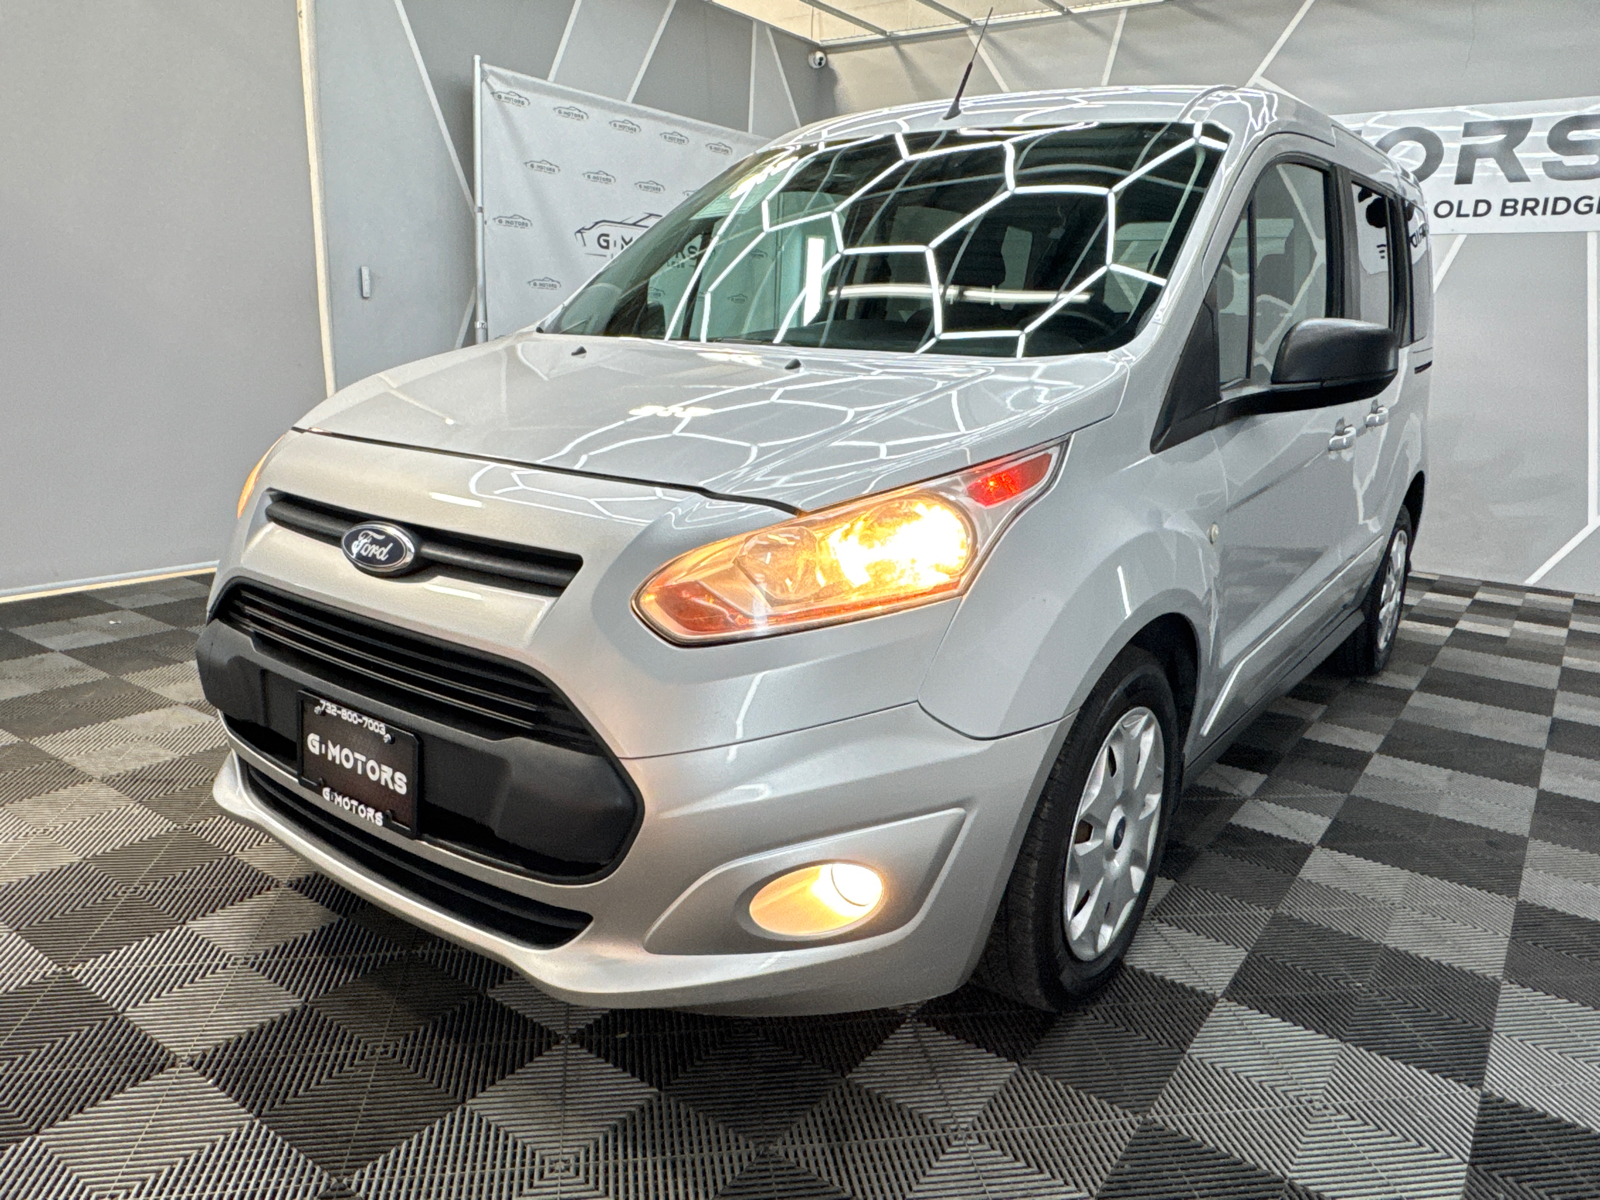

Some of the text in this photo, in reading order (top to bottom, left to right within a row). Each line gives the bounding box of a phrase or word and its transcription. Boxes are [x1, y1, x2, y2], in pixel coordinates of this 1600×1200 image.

[1352, 113, 1600, 185] ORS
[1433, 195, 1600, 219] OLD BRIDG
[351, 529, 394, 562] Ford
[319, 700, 387, 736] 732-800-7003
